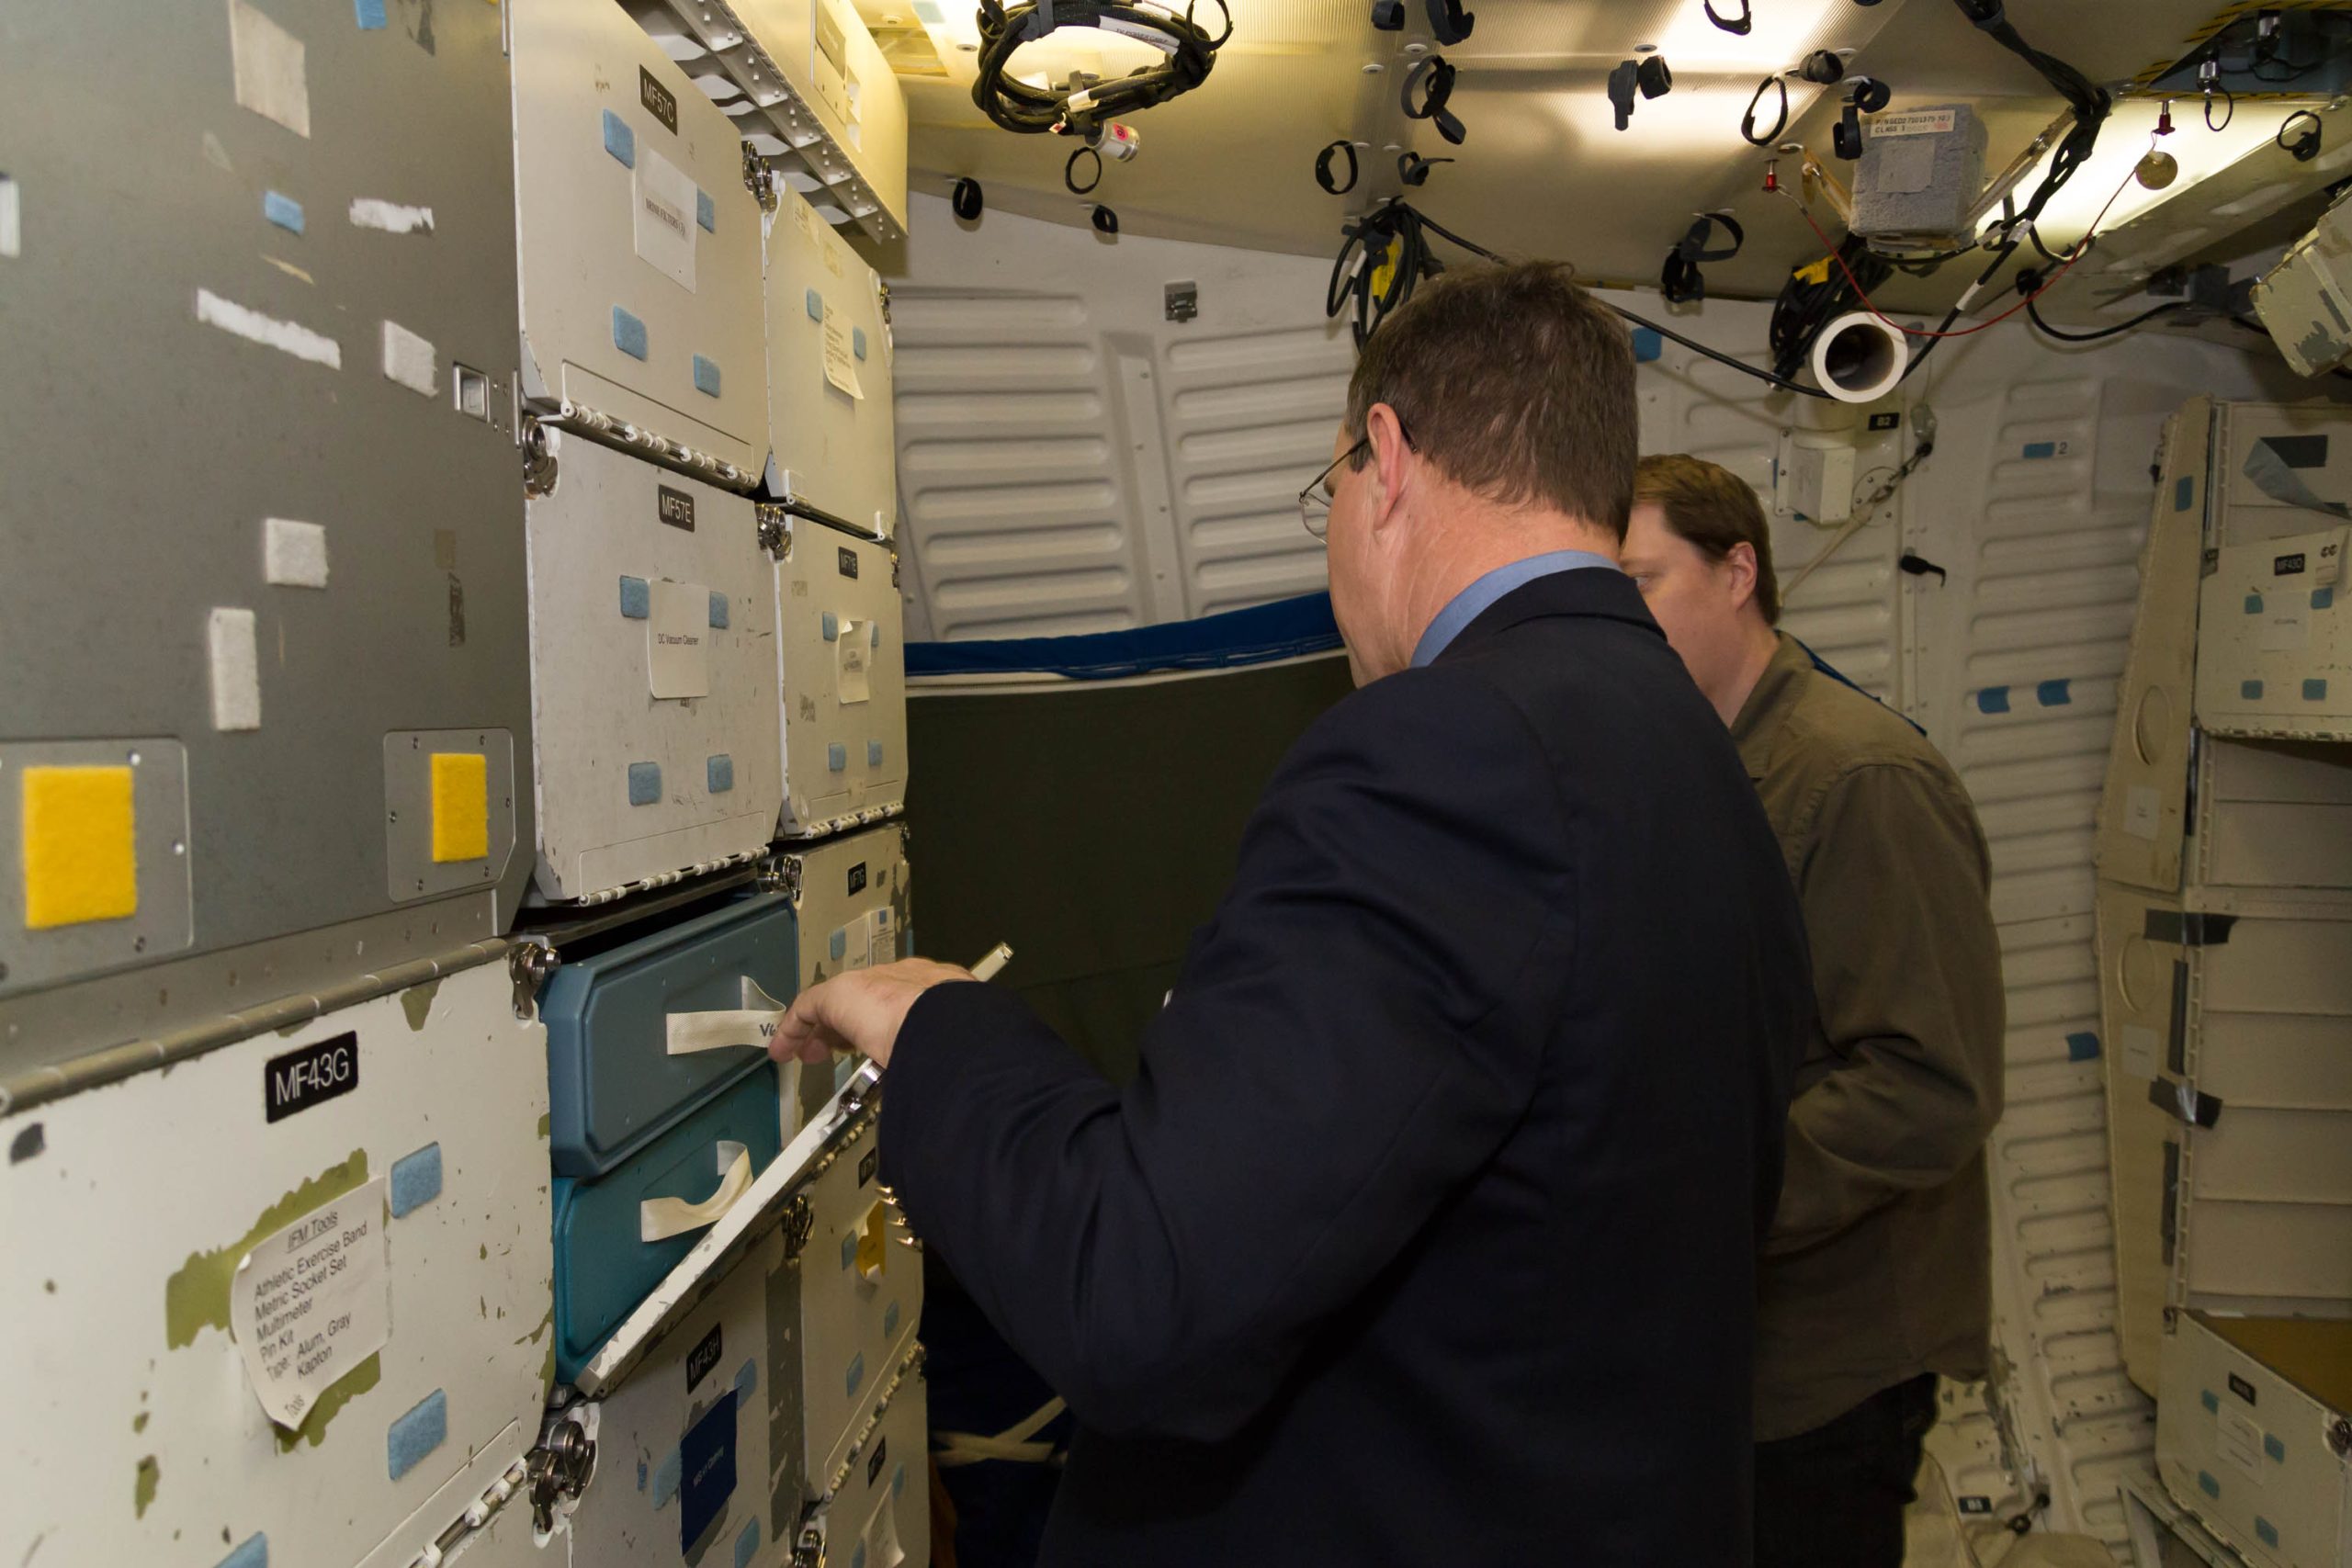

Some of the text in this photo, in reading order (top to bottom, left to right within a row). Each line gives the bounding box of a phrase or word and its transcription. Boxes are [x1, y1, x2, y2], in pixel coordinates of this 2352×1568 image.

[644, 78, 673, 123] MF57C
[2058, 441, 2067, 456] 2
[662, 493, 691, 524] MF57E
[276, 1047, 349, 1106] MF43G
[287, 1211, 338, 1250] IFM Tools
[254, 1220, 368, 1301] Athletic Exercise Band
[254, 1255, 348, 1323] Metric Socket Set
[256, 1298, 312, 1342] Multimeter
[327, 1312, 351, 1337] Gray
[260, 1330, 294, 1362] Pin Kit
[297, 1346, 333, 1379] Kapton
[690, 1335, 719, 1380] MF43H
[285, 1393, 305, 1418] Tools
